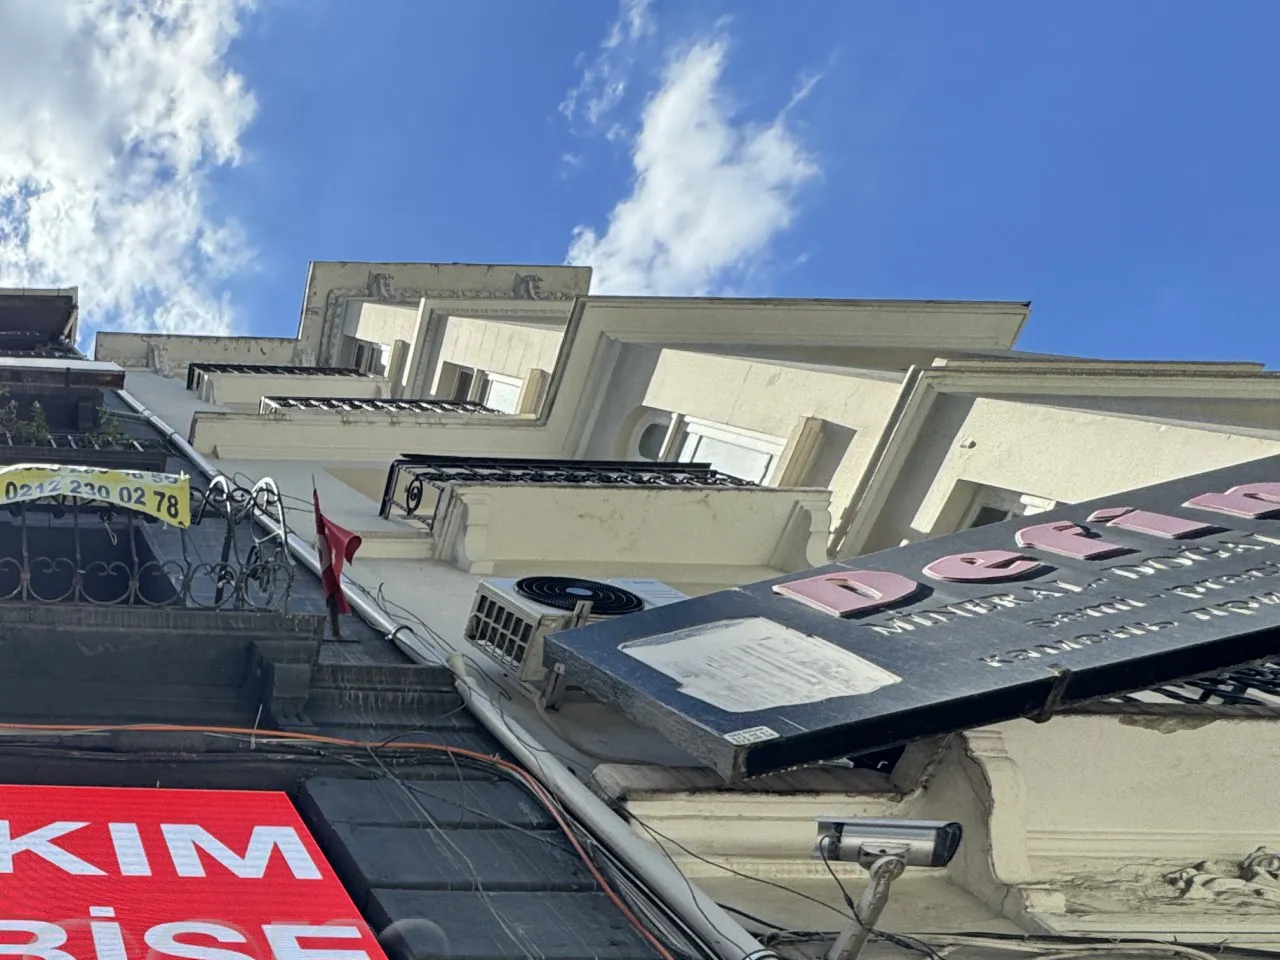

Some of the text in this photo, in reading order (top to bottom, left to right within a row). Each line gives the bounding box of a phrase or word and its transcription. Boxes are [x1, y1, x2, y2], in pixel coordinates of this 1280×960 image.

[5, 479, 62, 501] 0212
[70, 479, 110, 500] 230
[119, 485, 147, 506] 02
[152, 490, 180, 519] 78
